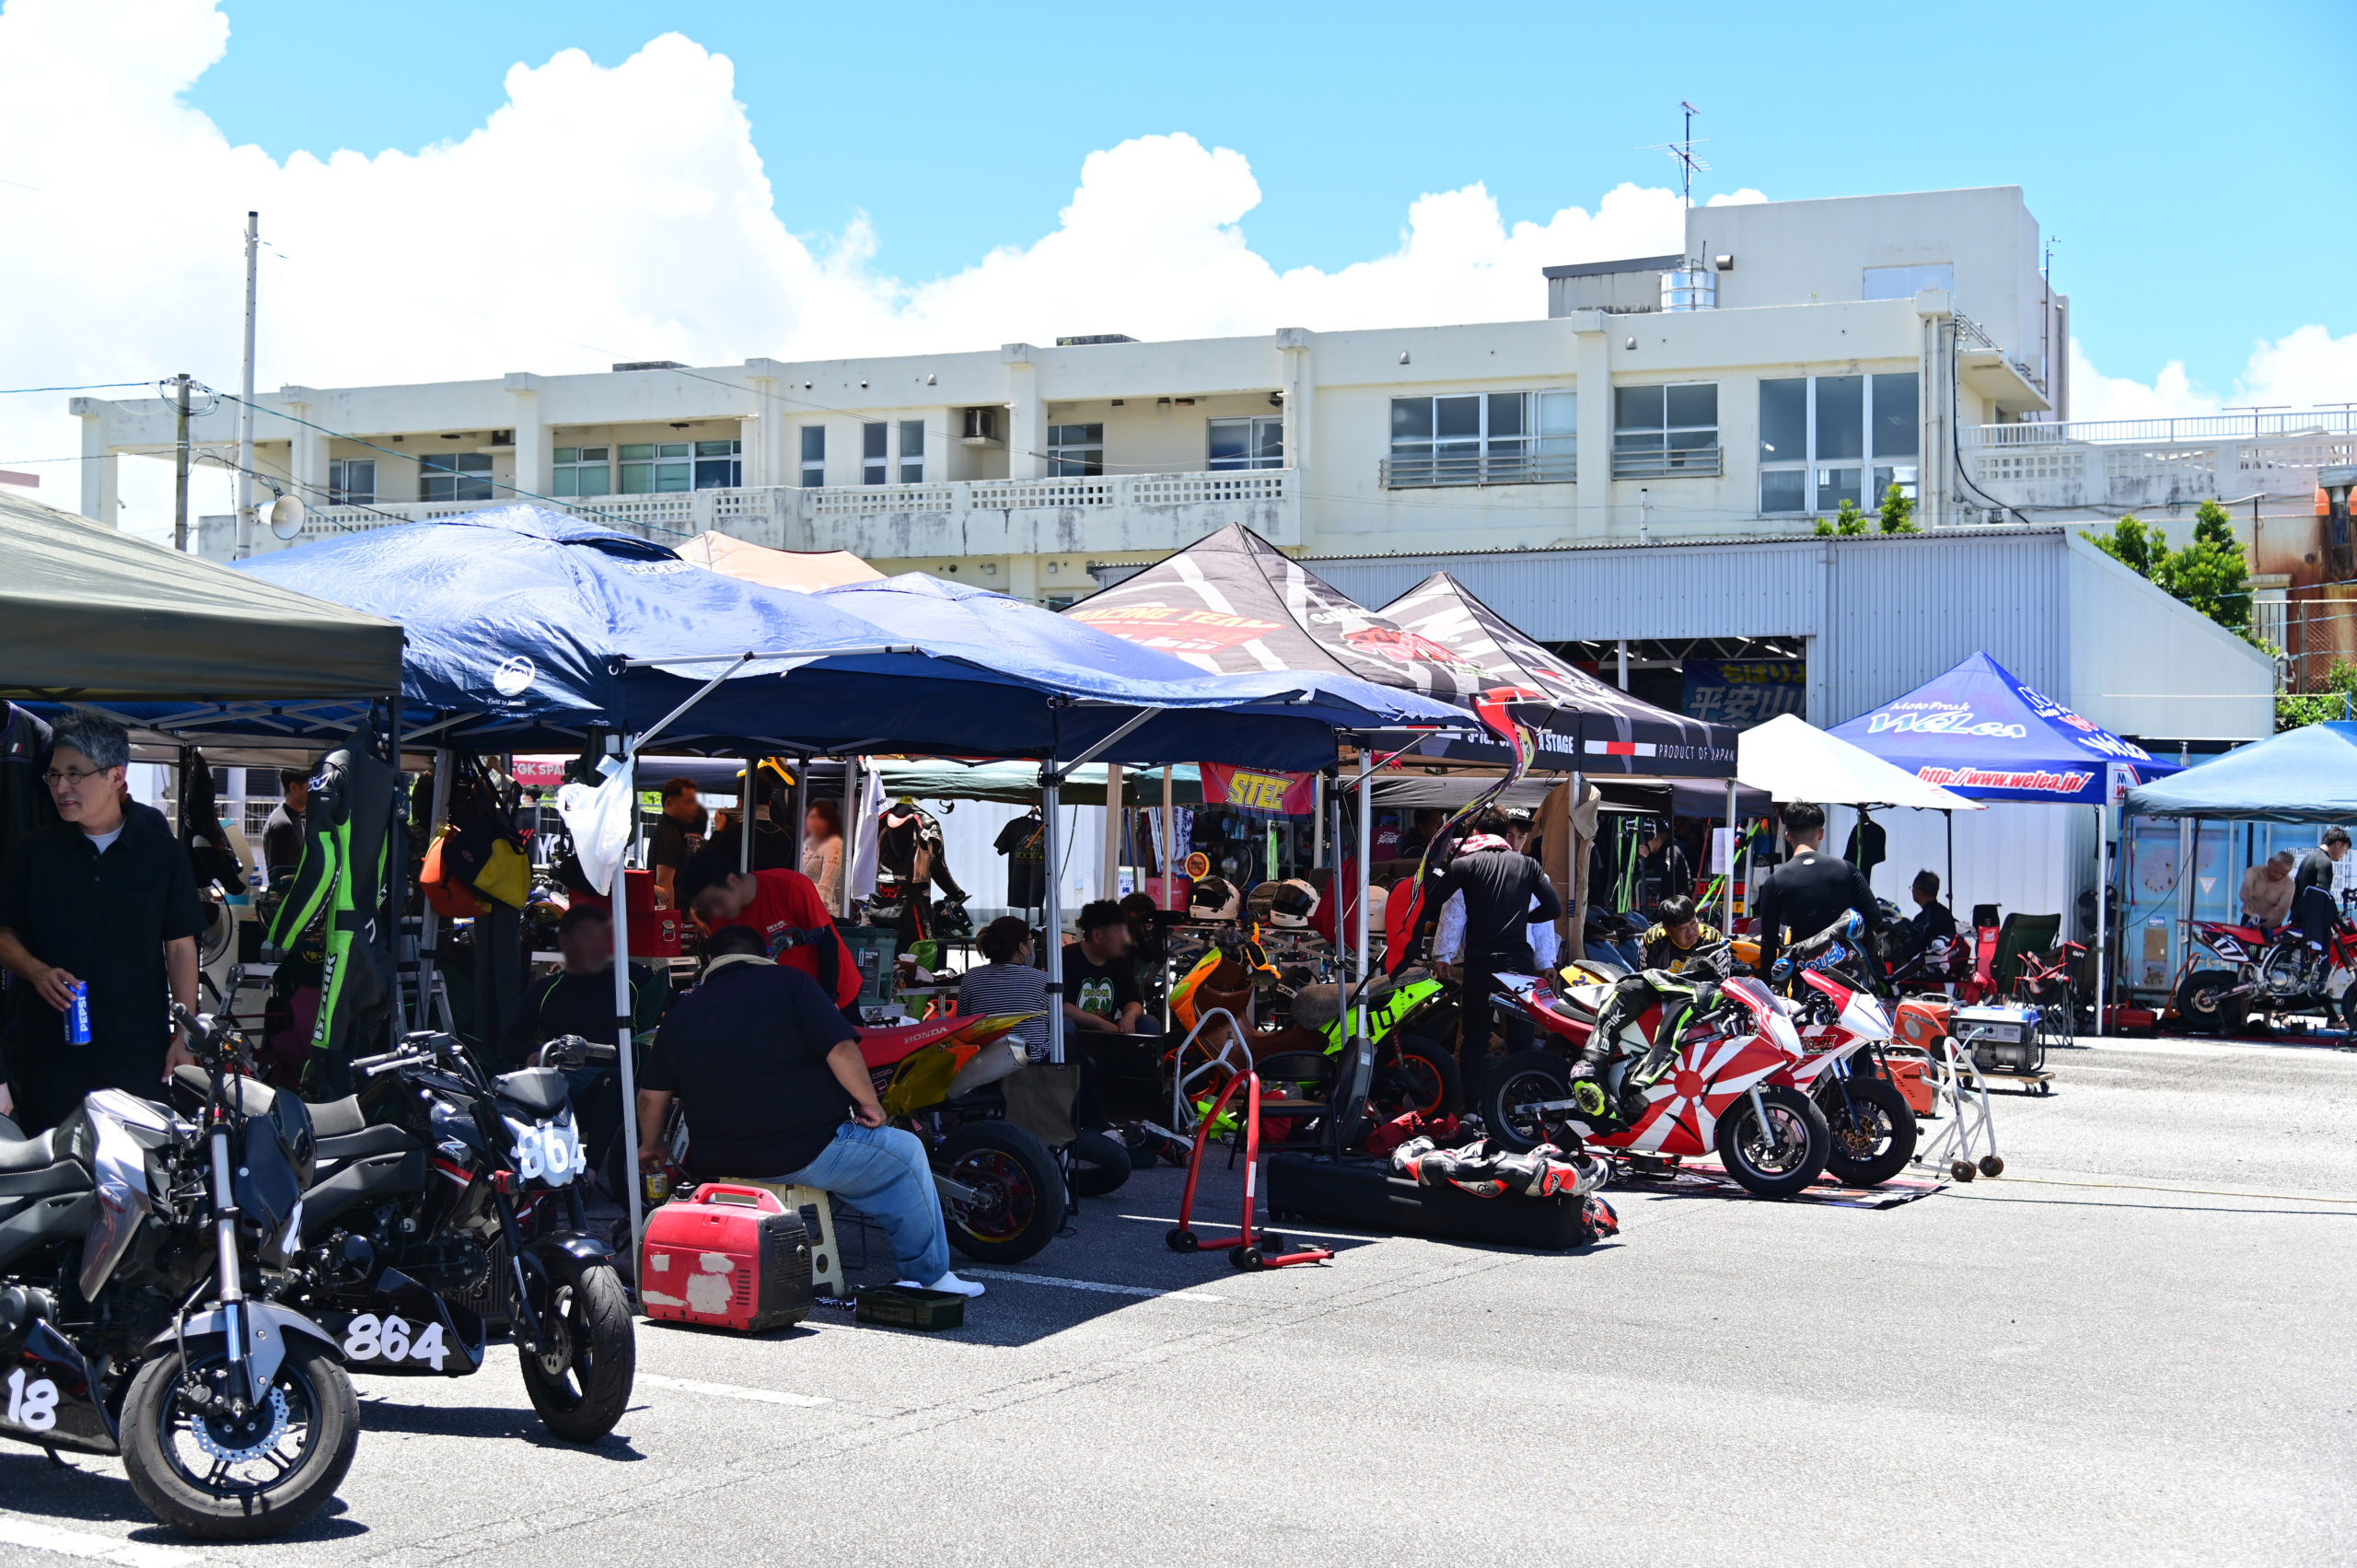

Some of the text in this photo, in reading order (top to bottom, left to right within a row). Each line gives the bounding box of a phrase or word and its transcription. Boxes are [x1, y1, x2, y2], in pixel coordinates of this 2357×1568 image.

[1689, 685, 1805, 721] 平安山
[1545, 734, 1574, 754] STAGE
[1658, 744, 1736, 763] PRODUCT OF JAPAN
[512, 763, 537, 776] GK
[1227, 772, 1291, 810] STEC
[1084, 989, 1109, 997] MOON
[77, 996, 88, 1032] PEPSI
[904, 1026, 948, 1044] HONDA
[517, 1121, 586, 1179] 864
[336, 1312, 451, 1372] 864
[7, 1367, 60, 1431] 18
